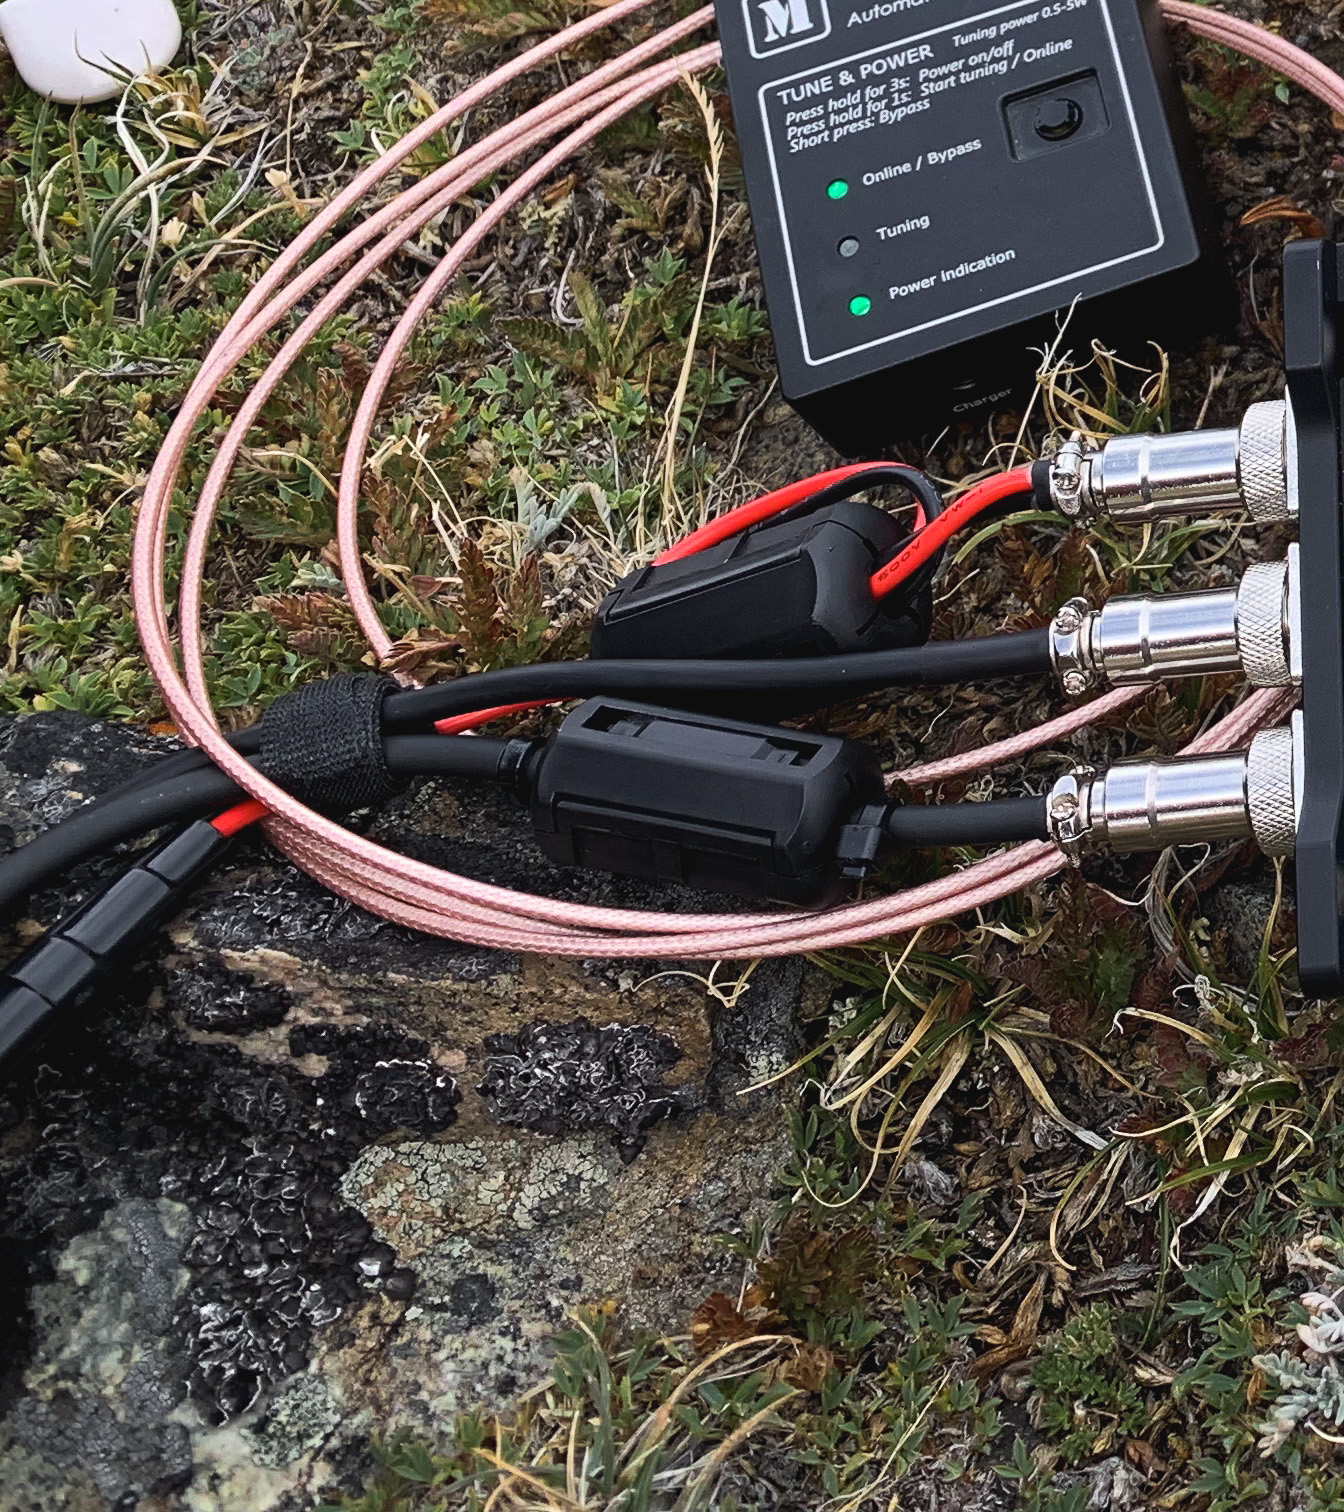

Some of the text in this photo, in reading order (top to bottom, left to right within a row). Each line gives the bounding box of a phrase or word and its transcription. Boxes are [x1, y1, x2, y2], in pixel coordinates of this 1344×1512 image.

[952, 25, 996, 47] Tuning
[1000, 12, 1039, 36] power
[777, 44, 934, 105] TUNE & POWER
[786, 39, 1015, 126] Press hold for 3s: Power on/off
[787, 39, 1073, 141] Press hold for 1s: Start tuning / Online
[789, 99, 930, 153] Short press: Bypass
[862, 139, 982, 186] Online / Bypass
[876, 216, 930, 240] Tuning
[889, 276, 936, 300] Power
[952, 388, 1013, 413] Charger
